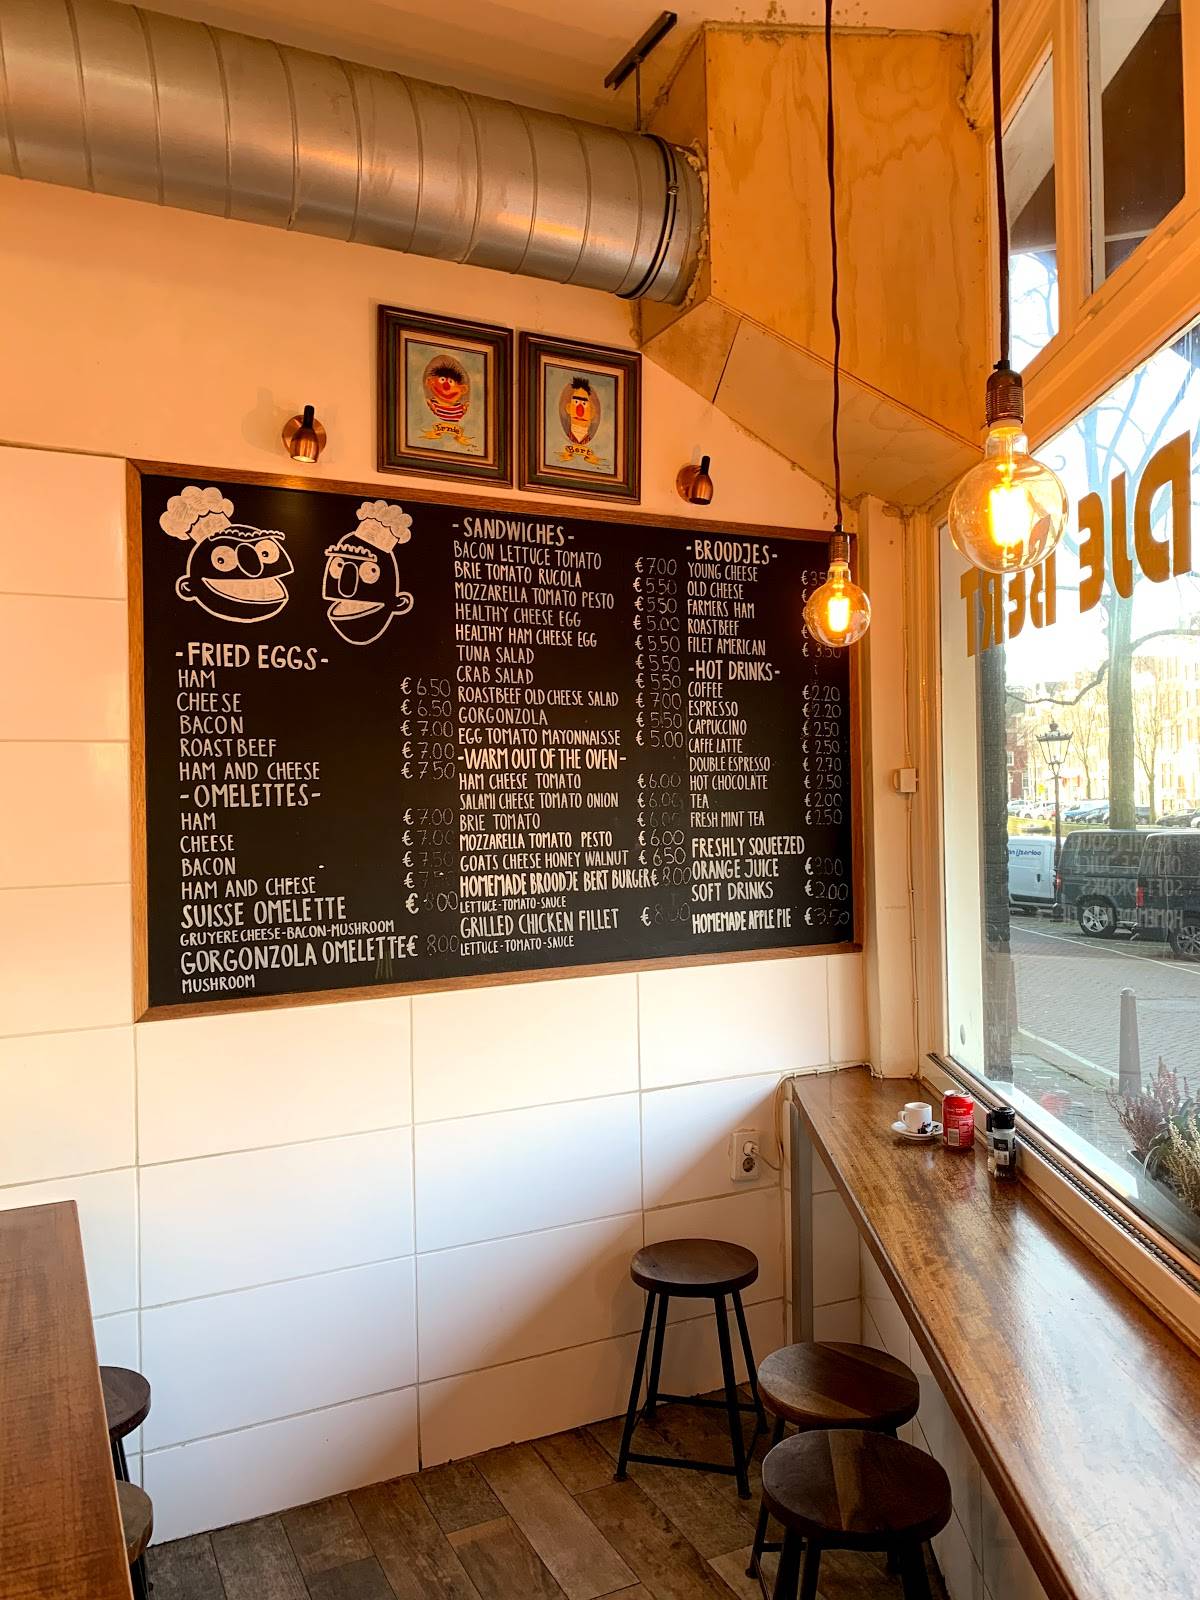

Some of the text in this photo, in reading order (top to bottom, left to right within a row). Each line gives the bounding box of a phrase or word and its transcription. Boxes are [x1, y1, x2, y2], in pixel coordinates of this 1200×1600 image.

[566, 445, 592, 456] Bert
[453, 540, 494, 560] BACON
[500, 544, 551, 566] LETTUCE
[554, 549, 602, 570] TOMATO
[454, 560, 482, 580] BRIE
[484, 563, 532, 584] TOMATO
[538, 568, 582, 588] RUCOLA
[687, 561, 758, 582] YOUNG CHEESE
[454, 581, 528, 603] MOZZARELLA
[531, 587, 577, 607] TOMATO
[582, 591, 614, 610] PESTO
[687, 580, 744, 600] OLD CHEESE
[455, 602, 509, 623] HEALTHY
[513, 608, 554, 626] CHEESE
[559, 610, 581, 627] EGG
[687, 598, 755, 619] FARMERS HAM
[455, 623, 504, 643] HEALTHY
[508, 627, 532, 645] HAM
[536, 629, 573, 647] CHEESE
[577, 631, 597, 648] EGG
[687, 618, 740, 636] ROASTBEEF
[455, 644, 491, 662] TUNA
[495, 646, 534, 664] SALAD
[687, 636, 766, 656] FILET AMERICAN
[178, 668, 216, 689] HAM
[456, 665, 534, 685] CRAB SALAD
[458, 685, 619, 707] ROASTBEEF OLD CHEESE SALAD
[688, 681, 723, 699] COFFEE
[176, 692, 242, 713] CHEESE
[688, 700, 738, 717] ESPRESSO
[179, 715, 244, 735] BACON
[458, 706, 548, 726] GORGONZOLA
[458, 727, 483, 745] EGG
[485, 727, 538, 745] TOMATO
[542, 729, 621, 746] MAYONNAISSE
[688, 718, 747, 735] CAPPUCCINO
[180, 738, 233, 758] ROAST
[237, 738, 277, 758] BEEF
[688, 738, 714, 753] CAFFE
[716, 738, 743, 754] LATTE
[511, 748, 538, 770] OUT
[540, 748, 556, 769] OF
[557, 748, 582, 770] THE
[689, 756, 726, 772] DOUBLE
[728, 756, 771, 772] ESPRESSO
[179, 761, 216, 781] HAM
[224, 762, 258, 780] AND
[267, 761, 320, 780] CHEESE
[459, 772, 484, 791] HAM
[489, 773, 528, 790] CHEESE
[534, 773, 581, 790] TOMATO
[690, 774, 768, 791] HOT CHOCOLATE
[459, 792, 619, 810] SALAMI CHEESE TOMATO ONION
[689, 793, 709, 809] TEA
[181, 812, 216, 831] HAM
[460, 813, 540, 832] BRIE TOMATO
[690, 812, 718, 828] FRESH
[721, 811, 745, 828] MINT
[747, 810, 765, 827] TEA
[180, 834, 235, 854] CHEESE
[459, 833, 525, 852] MOZZARELLA
[528, 832, 572, 849] TOMATO
[581, 830, 612, 848] PESTO
[692, 835, 805, 858] FRESHLY SQUEEZED
[181, 857, 236, 877] BACON
[460, 850, 629, 872] GOATS CHEESE HONEY WALNUT
[692, 859, 741, 881] ORANGE
[744, 858, 779, 878] JUICE
[181, 876, 316, 900] HAM AND CHEESE
[460, 873, 527, 898] HOMEMADE
[530, 871, 579, 895] BROODJE
[583, 869, 609, 892] BERT
[612, 868, 651, 889] BURGER
[691, 882, 722, 902] SOFT
[727, 881, 774, 901] DRINKS
[181, 896, 346, 929] SUISSE OMELETTE
[692, 910, 747, 934] HOMEMADE
[748, 909, 775, 930] APPLE
[777, 908, 791, 928] PIE
[460, 915, 514, 939] GRILLED
[518, 911, 574, 934] CHICKEN
[579, 908, 619, 931] FILLET
[180, 930, 239, 947] GRUYERE
[181, 935, 406, 975] GORGONZOLA OMELETTE
[182, 974, 255, 994] MUSHROOM
